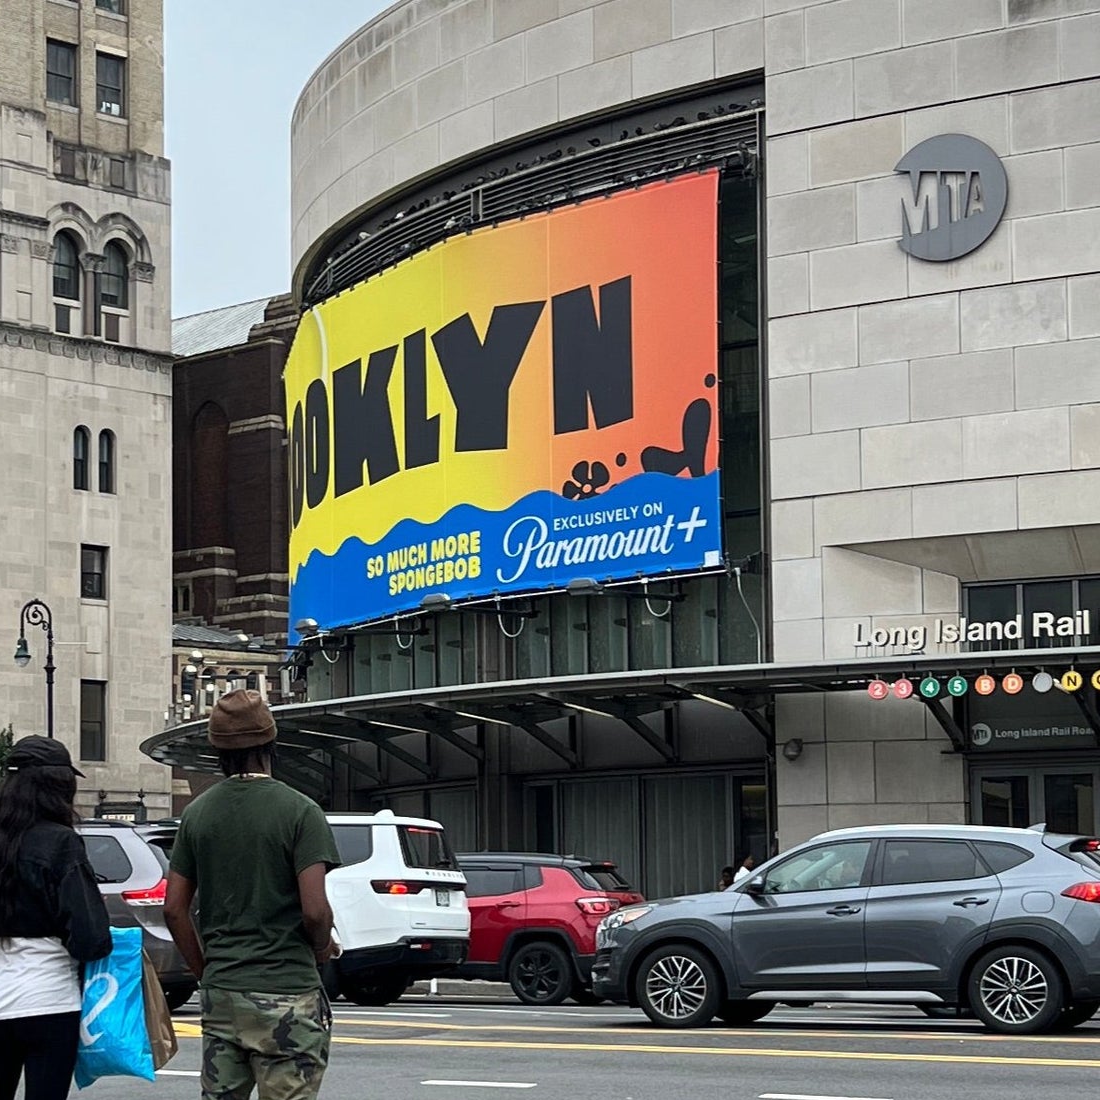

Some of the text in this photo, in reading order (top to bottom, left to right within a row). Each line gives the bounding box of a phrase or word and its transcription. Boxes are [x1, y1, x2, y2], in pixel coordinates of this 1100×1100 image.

[288, 275, 635, 530] OOKLYN
[552, 502, 663, 531] EXCLUSIVELY ON
[367, 531, 481, 579] SO MUCH MORE
[388, 555, 481, 596] SPONGEBOB
[853, 610, 1090, 650] Long Island Rail
[995, 729, 1020, 740] Long
[1021, 727, 1050, 738] Island
[1051, 726, 1071, 737] Rail
[1071, 725, 1095, 736] Roa
